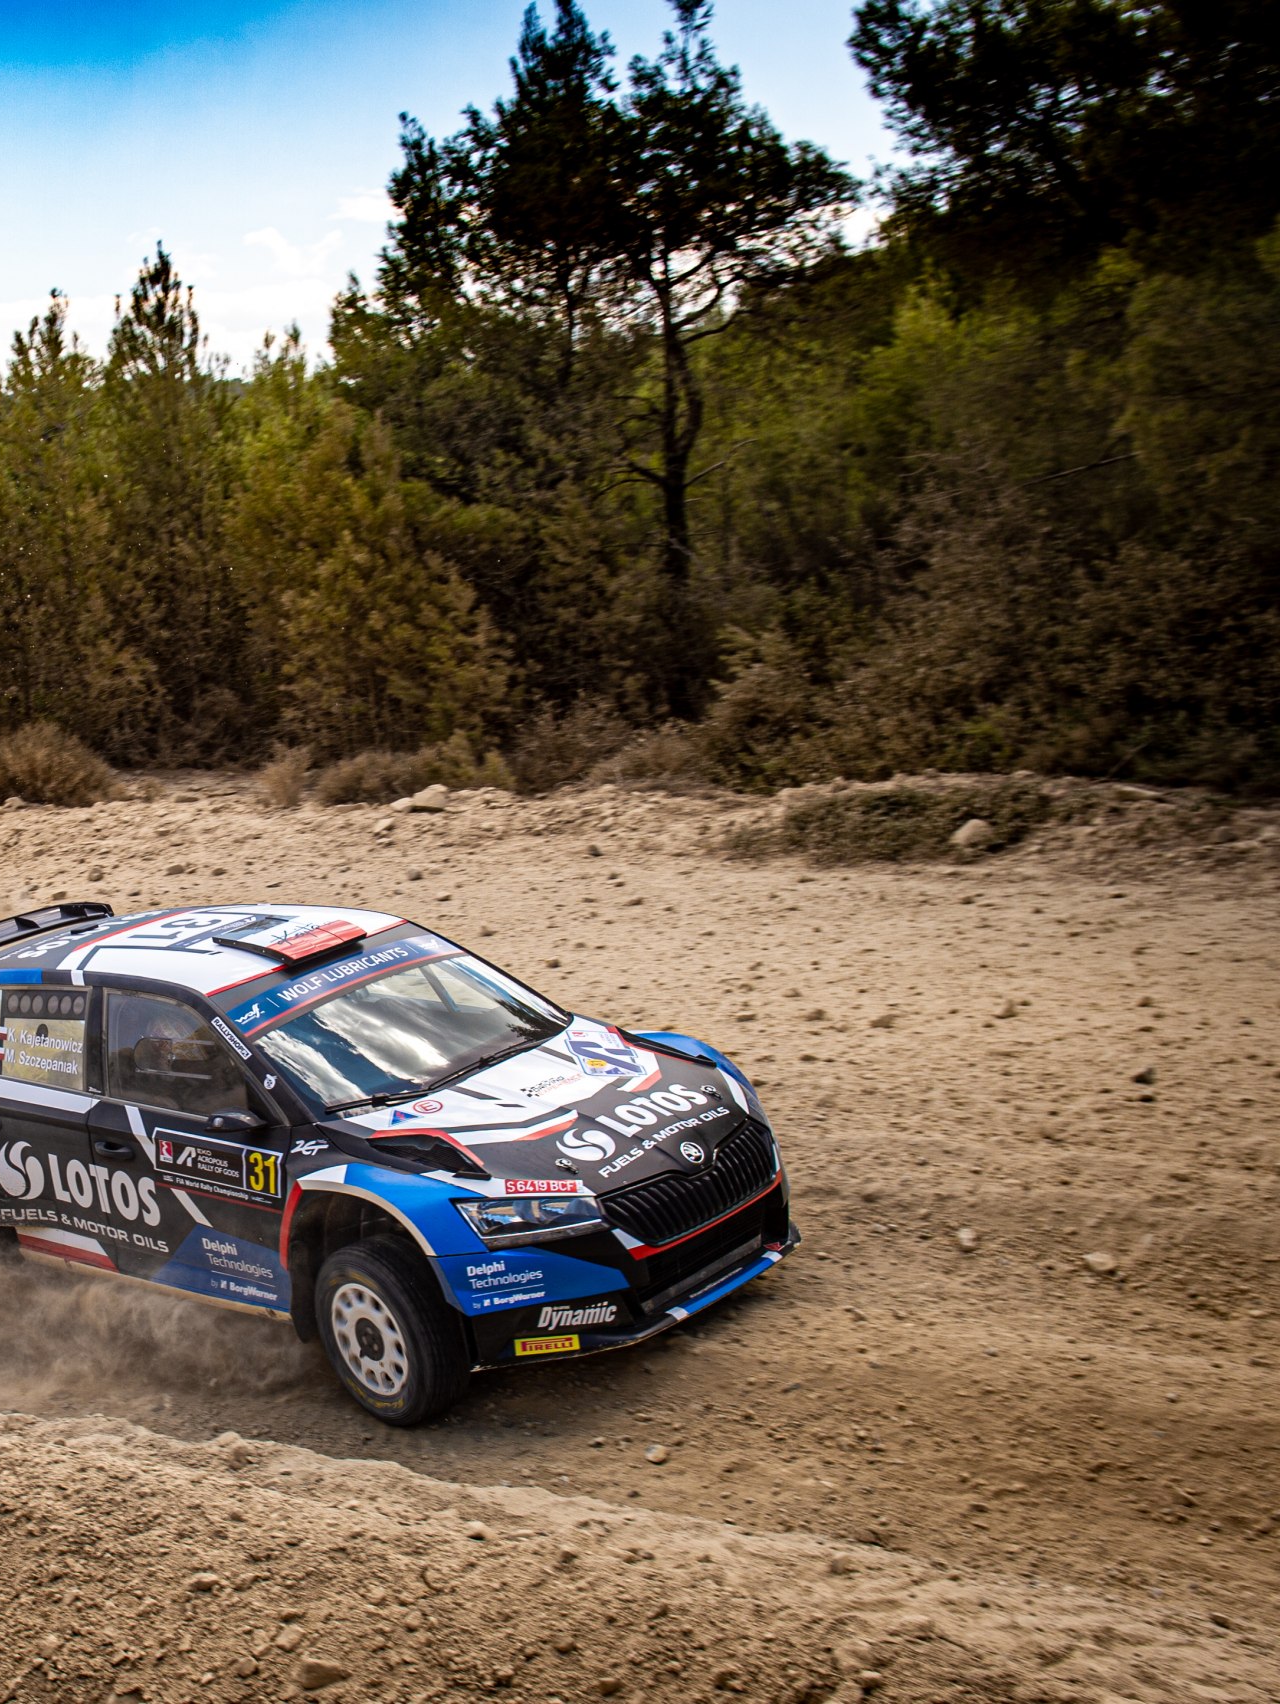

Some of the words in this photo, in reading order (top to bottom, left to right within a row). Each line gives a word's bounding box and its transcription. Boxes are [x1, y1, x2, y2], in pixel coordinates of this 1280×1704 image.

[277, 973, 322, 1002] WOLF
[322, 947, 409, 983] LUBRICANTS
[7, 1027, 17, 1043] K.
[20, 1029, 83, 1054] Kajetanowicz
[5, 1048, 16, 1064] M.
[19, 1050, 78, 1075] Szczepaniak
[595, 1084, 708, 1138] LOTOS
[598, 1147, 645, 1178] FUELS
[641, 1139, 657, 1150] &
[652, 1117, 703, 1142] MOTOR
[700, 1106, 730, 1122] OILS
[197, 1155, 228, 1167] ACROPOLIS
[197, 1163, 214, 1172] RALLY
[214, 1166, 223, 1174] OF
[223, 1168, 240, 1178] GODS
[249, 1152, 276, 1194] 31
[48, 1153, 161, 1227] LOTOS
[0, 1208, 58, 1222] FUELS
[61, 1213, 72, 1226] &
[73, 1216, 130, 1242] MOTOR
[132, 1233, 169, 1253] OILS
[201, 1237, 238, 1256] Delphi
[205, 1252, 274, 1279] Technologies
[466, 1260, 506, 1277] Delphi
[210, 1278, 219, 1289] by
[229, 1281, 278, 1301] BorgWarner
[469, 1270, 543, 1290] Technologies
[493, 1291, 546, 1305] BorgWarner
[537, 1301, 618, 1331] Dynamic
[521, 1336, 573, 1353] PIRELLI
